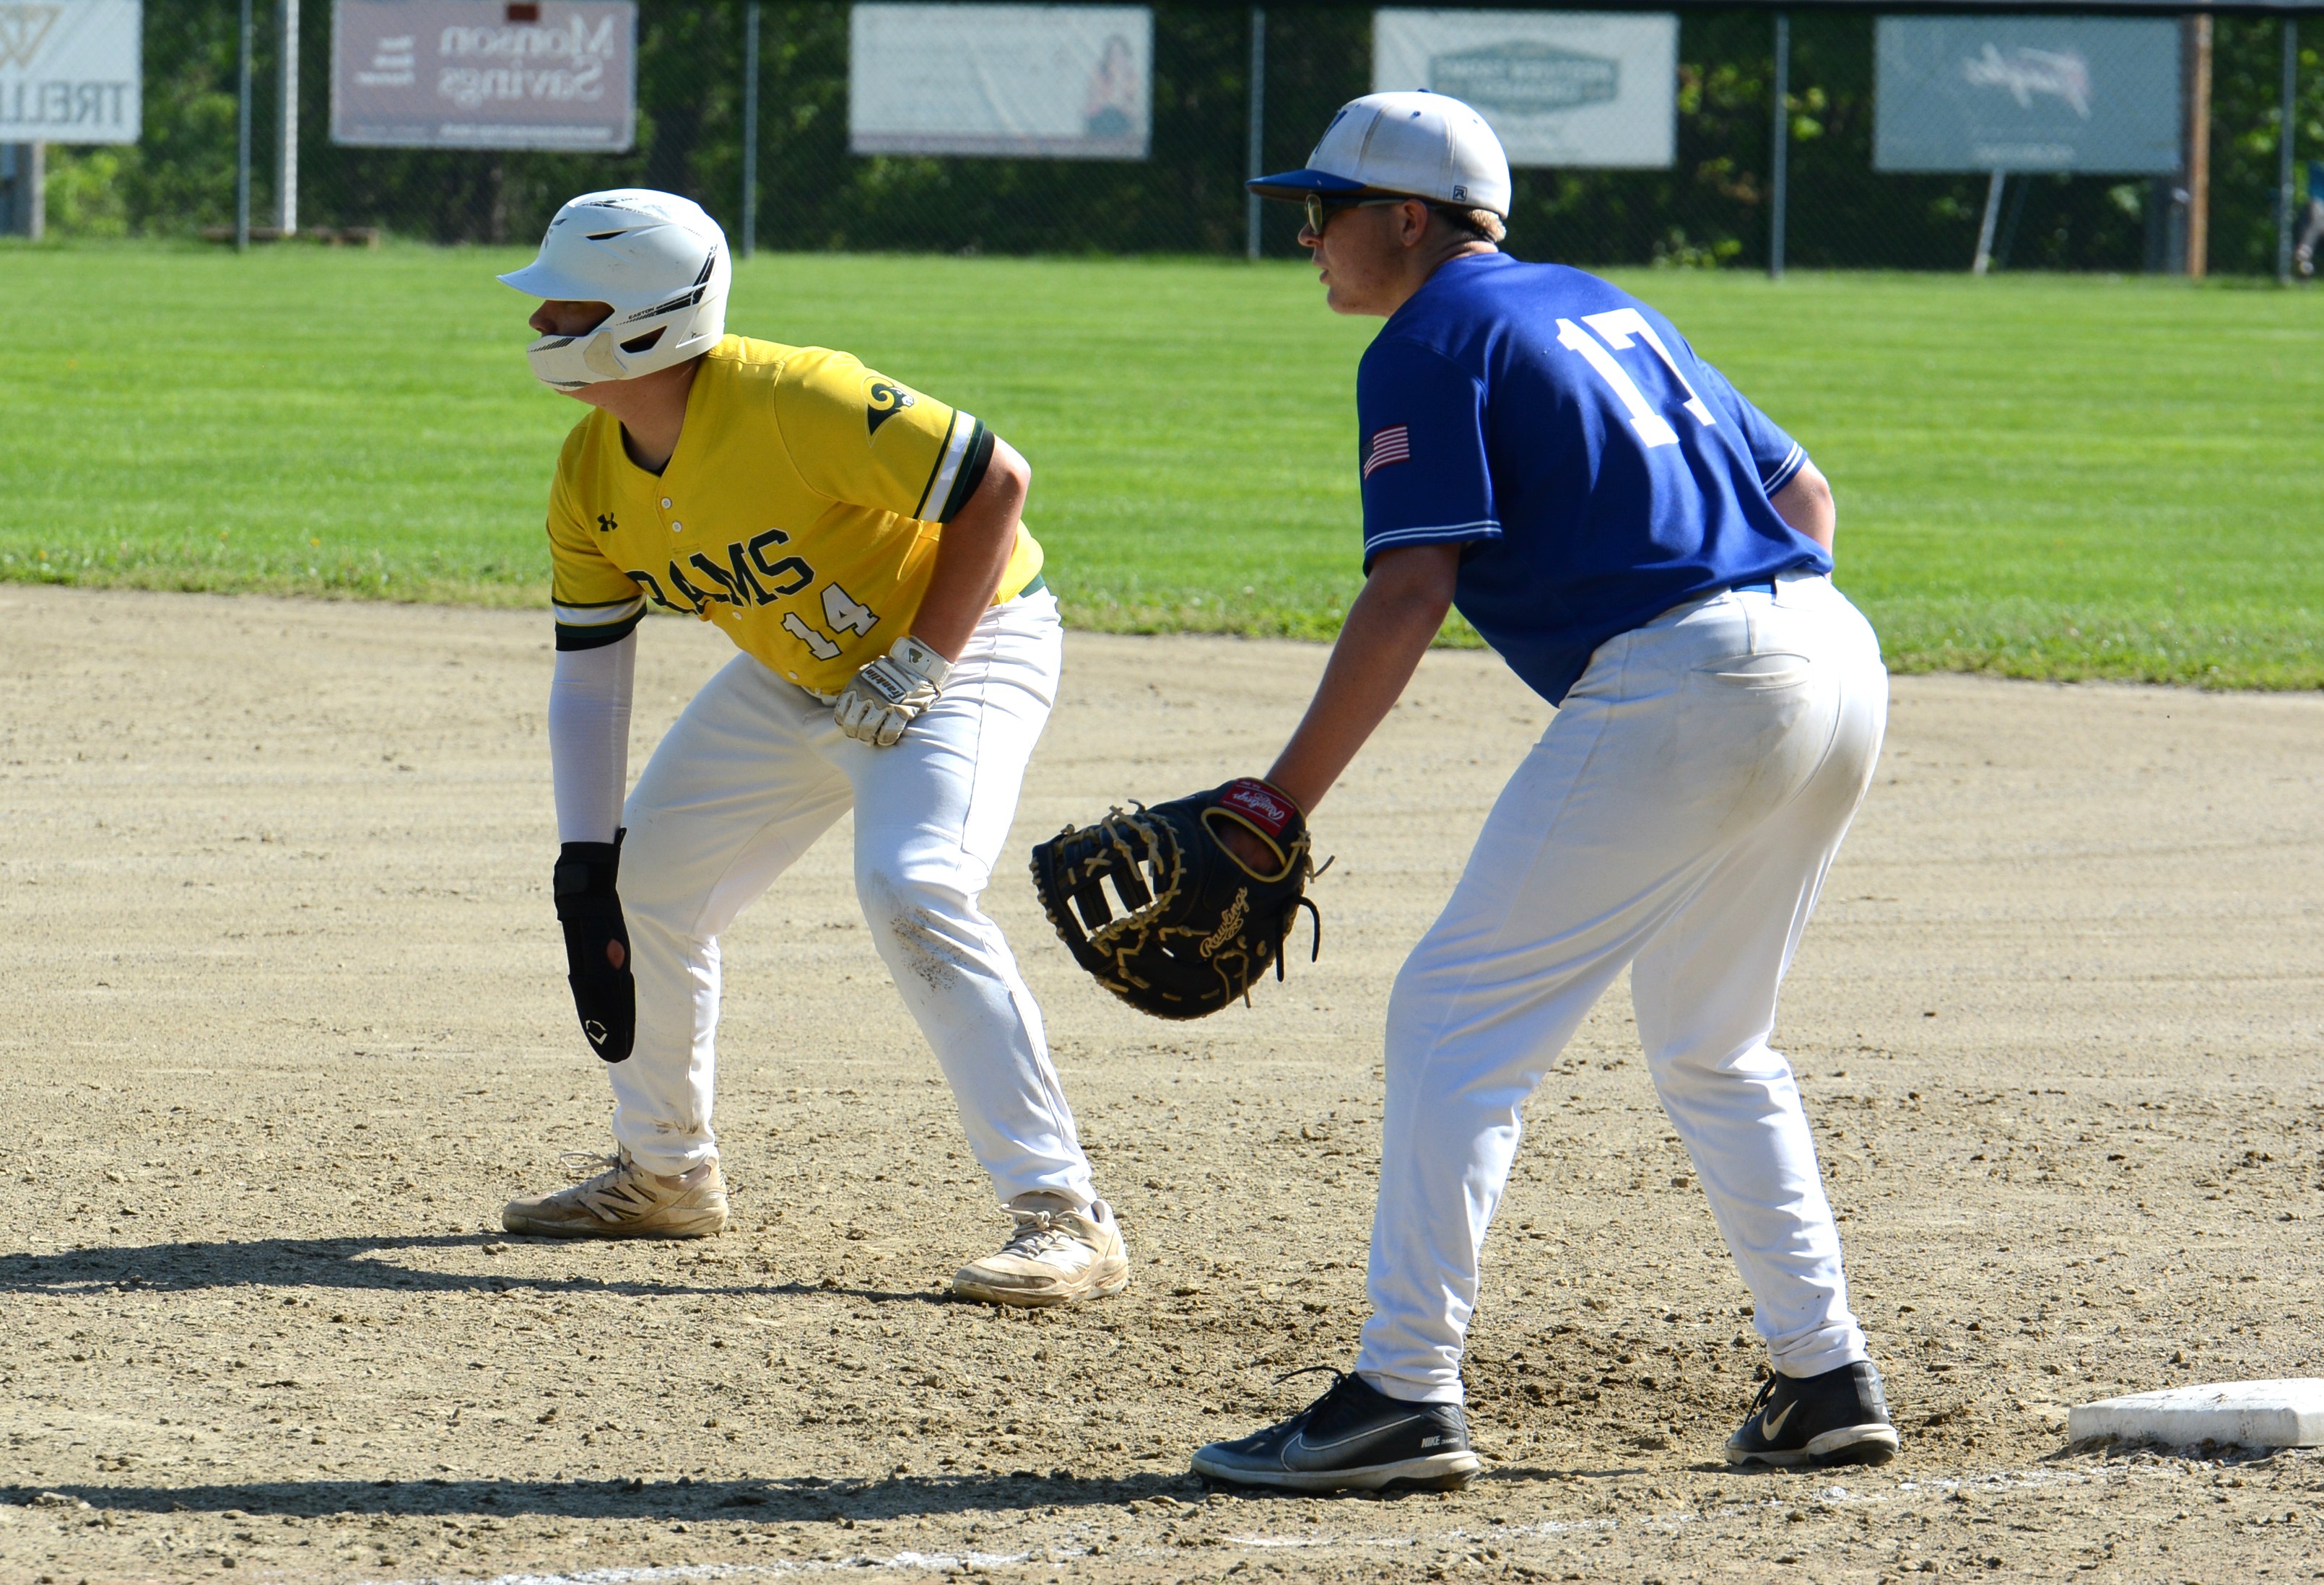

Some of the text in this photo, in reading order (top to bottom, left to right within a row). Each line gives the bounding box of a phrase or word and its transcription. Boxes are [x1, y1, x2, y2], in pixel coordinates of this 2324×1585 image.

[628, 307, 654, 320] EASTON
[1555, 307, 1717, 448] 17
[780, 581, 881, 662] 14
[1232, 790, 1285, 821] Rawlings
[1200, 886, 1250, 958] Rawlings
[1421, 1435, 1441, 1449] NIKE
